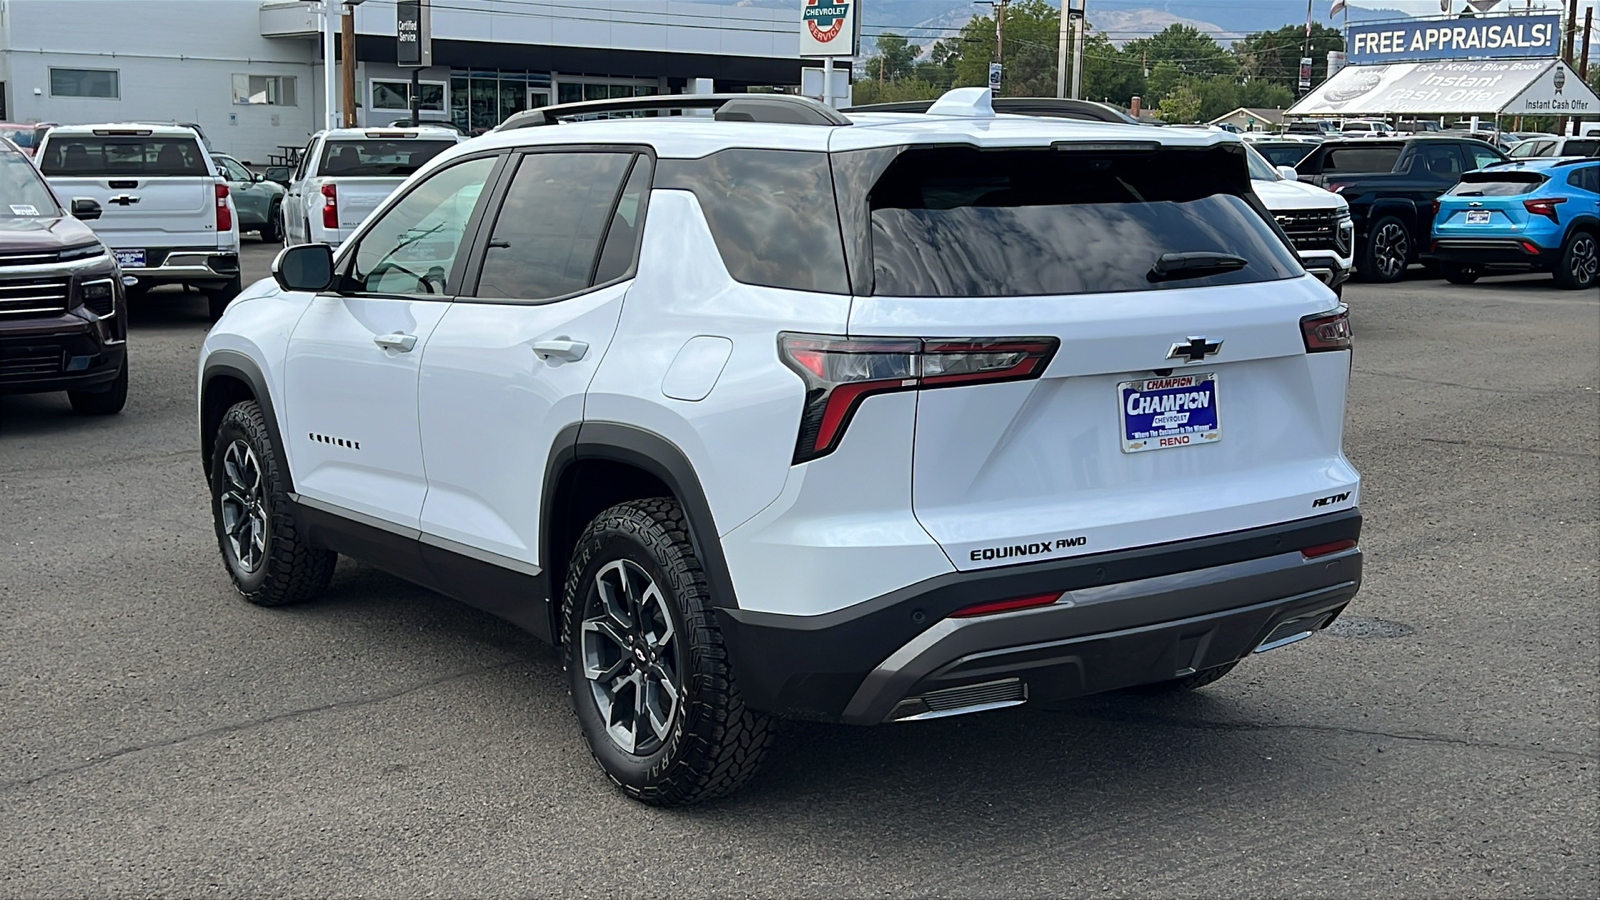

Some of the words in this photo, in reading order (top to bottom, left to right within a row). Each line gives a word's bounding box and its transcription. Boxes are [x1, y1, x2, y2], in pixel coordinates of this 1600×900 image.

[806, 7, 845, 16] CHEVROLET
[399, 20, 417, 30] Certified
[810, 22, 842, 41] SERVICE
[399, 31, 416, 42] Service
[1354, 30, 1405, 55] FREE
[1409, 23, 1552, 52] APPRAISALS!
[1444, 63, 1481, 73] Kelley
[1480, 63, 1508, 71] Blue
[1509, 62, 1541, 71] Book
[1419, 72, 1503, 87] Instant
[1384, 88, 1442, 101] Cash
[1444, 88, 1505, 102] Offer
[1525, 99, 1550, 109] Instant
[1552, 99, 1569, 110] Cash
[1571, 99, 1589, 110] Offer
[1146, 377, 1193, 390] CHAMPION
[1127, 391, 1210, 415] CHAMPION
[1154, 414, 1187, 424] CHEVROLET
[309, 432, 360, 450] EQUINOX
[1160, 436, 1190, 446] RENO
[1312, 491, 1351, 508] ACTIV
[970, 541, 1052, 561] EQUINOX
[1056, 537, 1086, 549] AWD
